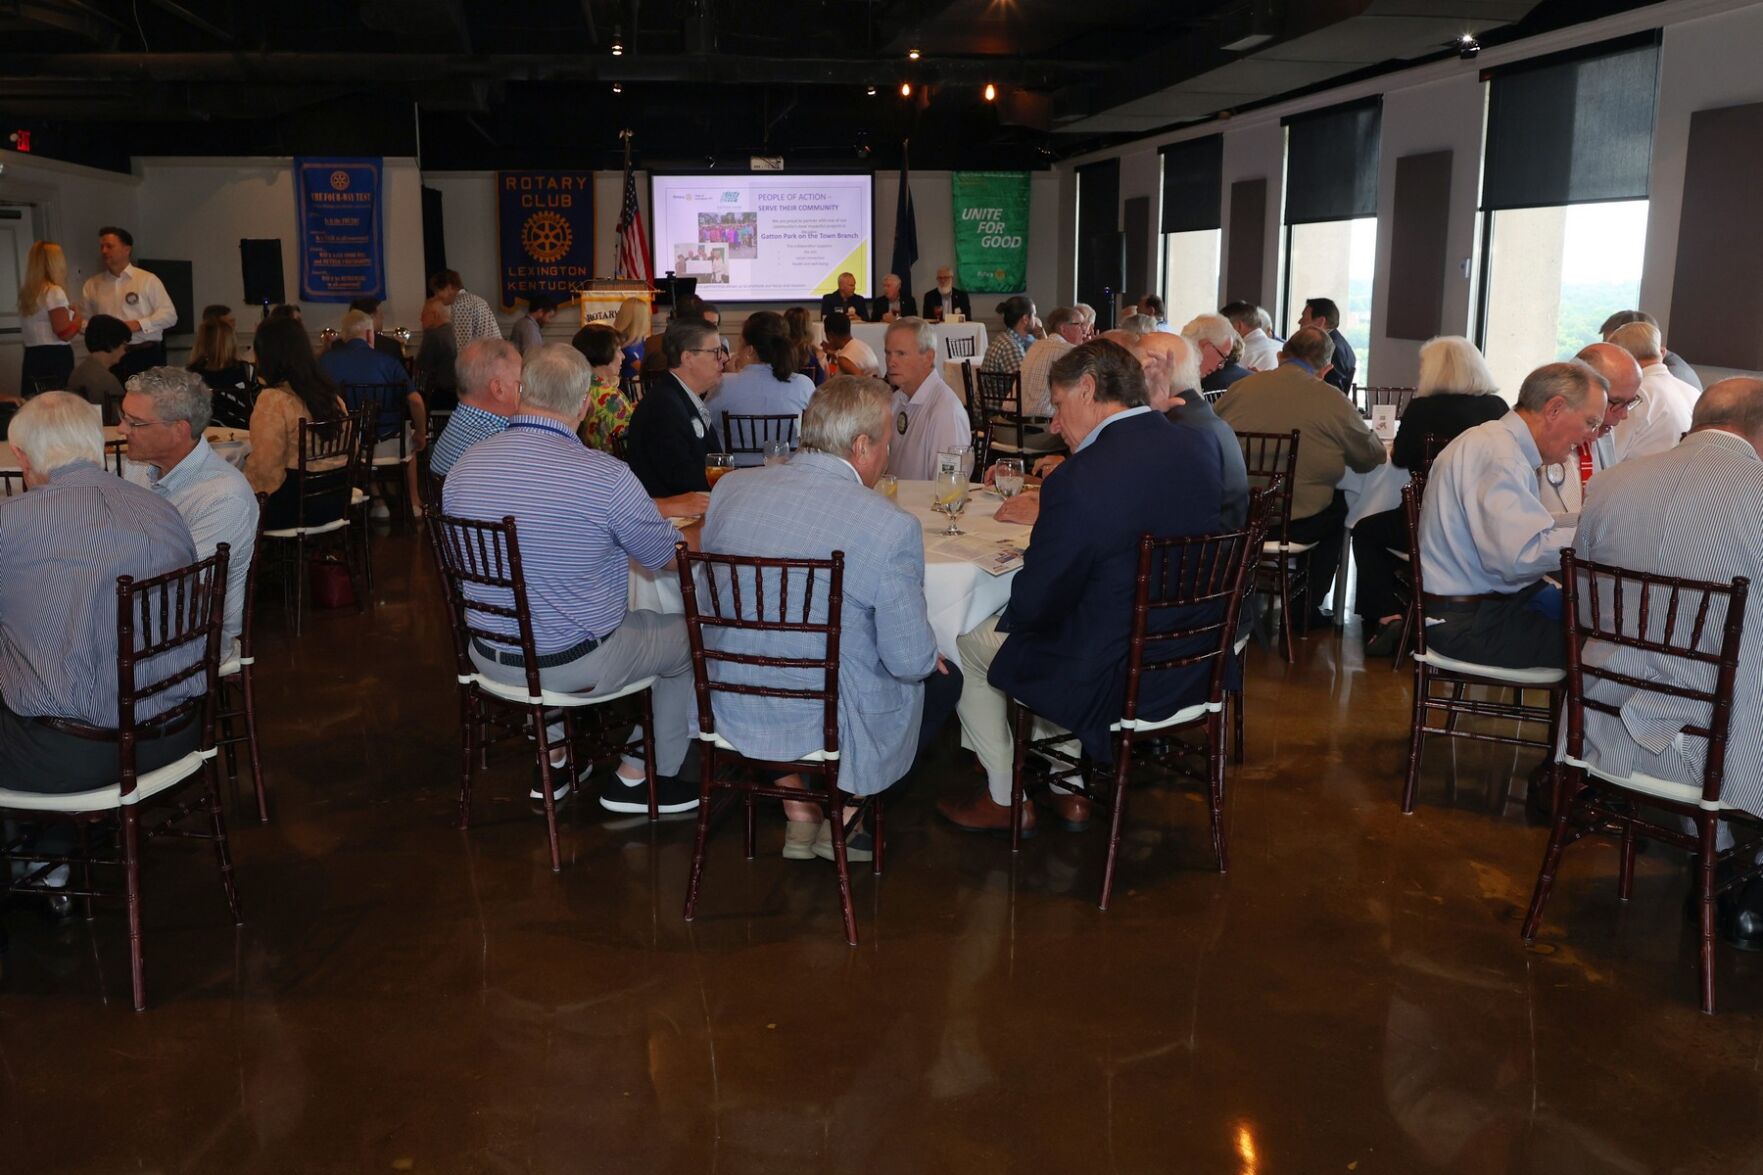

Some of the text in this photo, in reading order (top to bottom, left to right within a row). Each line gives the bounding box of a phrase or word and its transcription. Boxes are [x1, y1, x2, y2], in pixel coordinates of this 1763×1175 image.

[506, 177, 586, 190] ROTARY
[522, 194, 572, 207] CLUB
[758, 193, 784, 201] PEOPLE
[786, 193, 797, 201] OF
[798, 193, 827, 201] ACTION
[962, 208, 1003, 220] UNITE
[977, 221, 1005, 234] FOR
[981, 236, 1022, 249] GOOD
[509, 266, 587, 276] LEXINGTON
